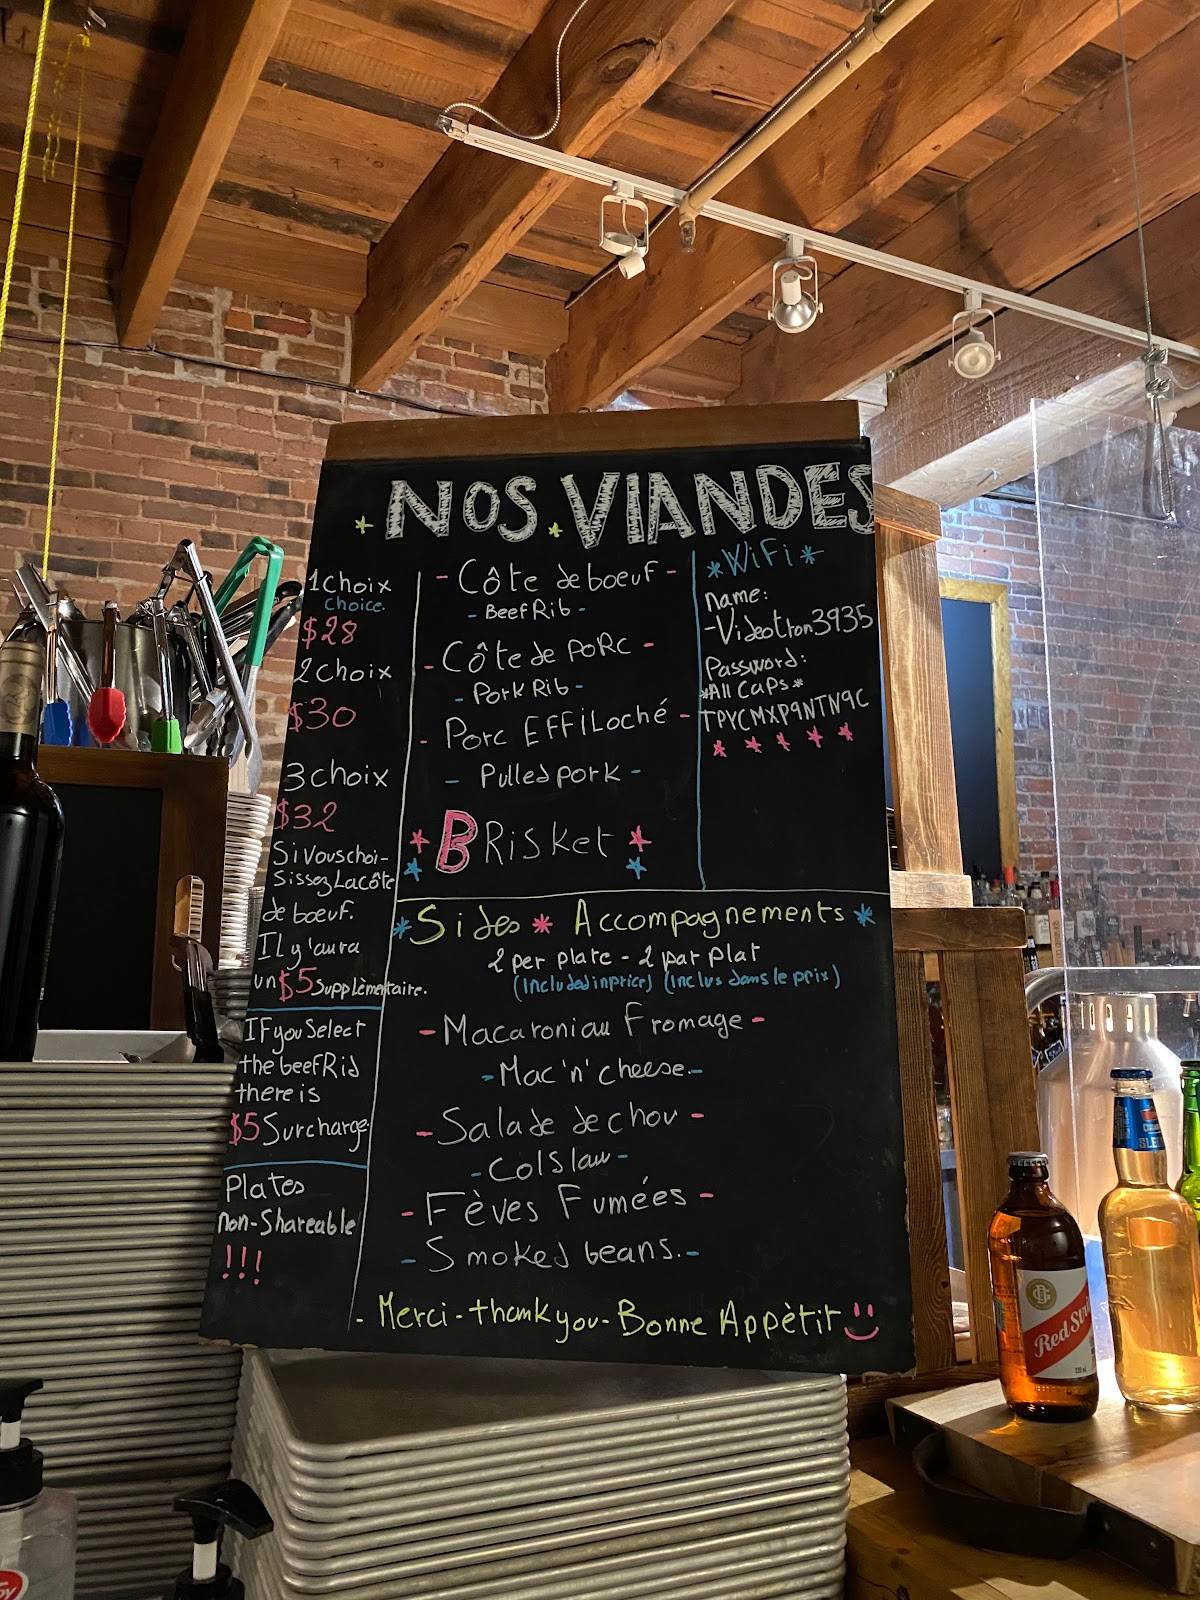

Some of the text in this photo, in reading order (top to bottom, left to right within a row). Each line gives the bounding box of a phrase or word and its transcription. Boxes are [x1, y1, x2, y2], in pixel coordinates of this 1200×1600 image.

[385, 462, 876, 549] NOS VIANDES
[458, 558, 539, 595] Côte
[556, 563, 580, 589] de
[532, 598, 571, 620] Rib
[301, 615, 357, 650] $28
[442, 640, 521, 673] Côte
[530, 641, 556, 666] de
[532, 677, 569, 698] Rib
[288, 697, 357, 733] $30
[445, 716, 507, 751] Porc
[481, 763, 550, 789] Pulled
[274, 798, 338, 832] $32
[262, 897, 286, 922] de
[409, 898, 845, 945] Sides Accompagnements
[487, 947, 505, 974] 2
[512, 953, 546, 974] per
[558, 946, 612, 970] plate
[638, 944, 655, 968] 2
[662, 950, 700, 972] par
[254, 974, 276, 989] un
[279, 967, 318, 1002] $5
[271, 1020, 303, 1055] you
[442, 1000, 745, 1048] Macaroni au Fromage
[239, 1054, 276, 1077] the
[234, 1083, 321, 1104] there is
[228, 1111, 261, 1147] $5
[437, 1105, 556, 1146] Salade
[571, 1104, 600, 1135] de
[1138, 1136, 1163, 1149] SLE
[225, 1172, 306, 1203] Plates
[425, 1175, 687, 1227] Fèves Fumées
[425, 1235, 571, 1273] Smoked
[378, 1291, 448, 1330] Merci
[468, 1295, 553, 1326] thank
[555, 1309, 601, 1344] you
[617, 1298, 708, 1337] Bonne
[1034, 1319, 1071, 1358] Red
